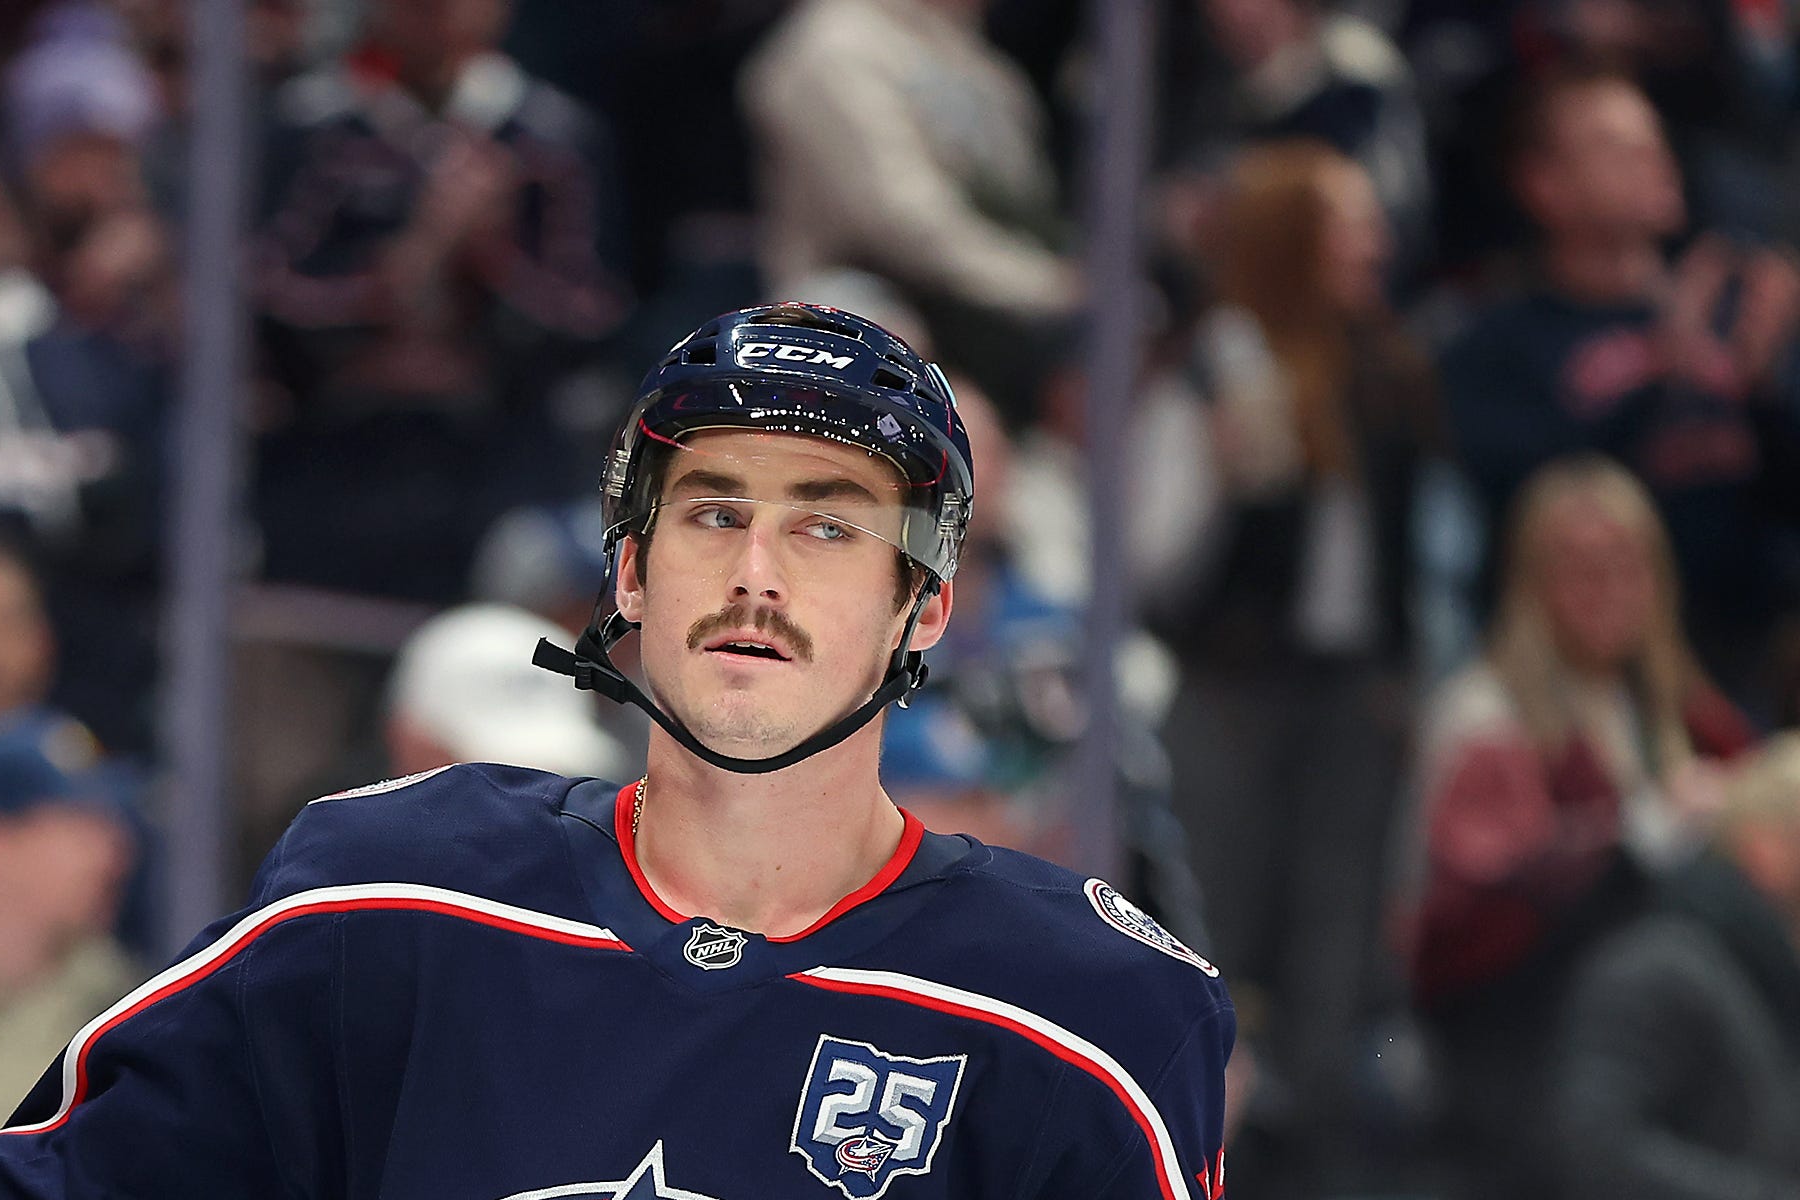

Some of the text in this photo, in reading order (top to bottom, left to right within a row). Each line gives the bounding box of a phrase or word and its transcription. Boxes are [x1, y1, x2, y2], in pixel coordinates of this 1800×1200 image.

[737, 342, 855, 371] CCM
[695, 940, 734, 958] NHL
[811, 1058, 938, 1162] 25
